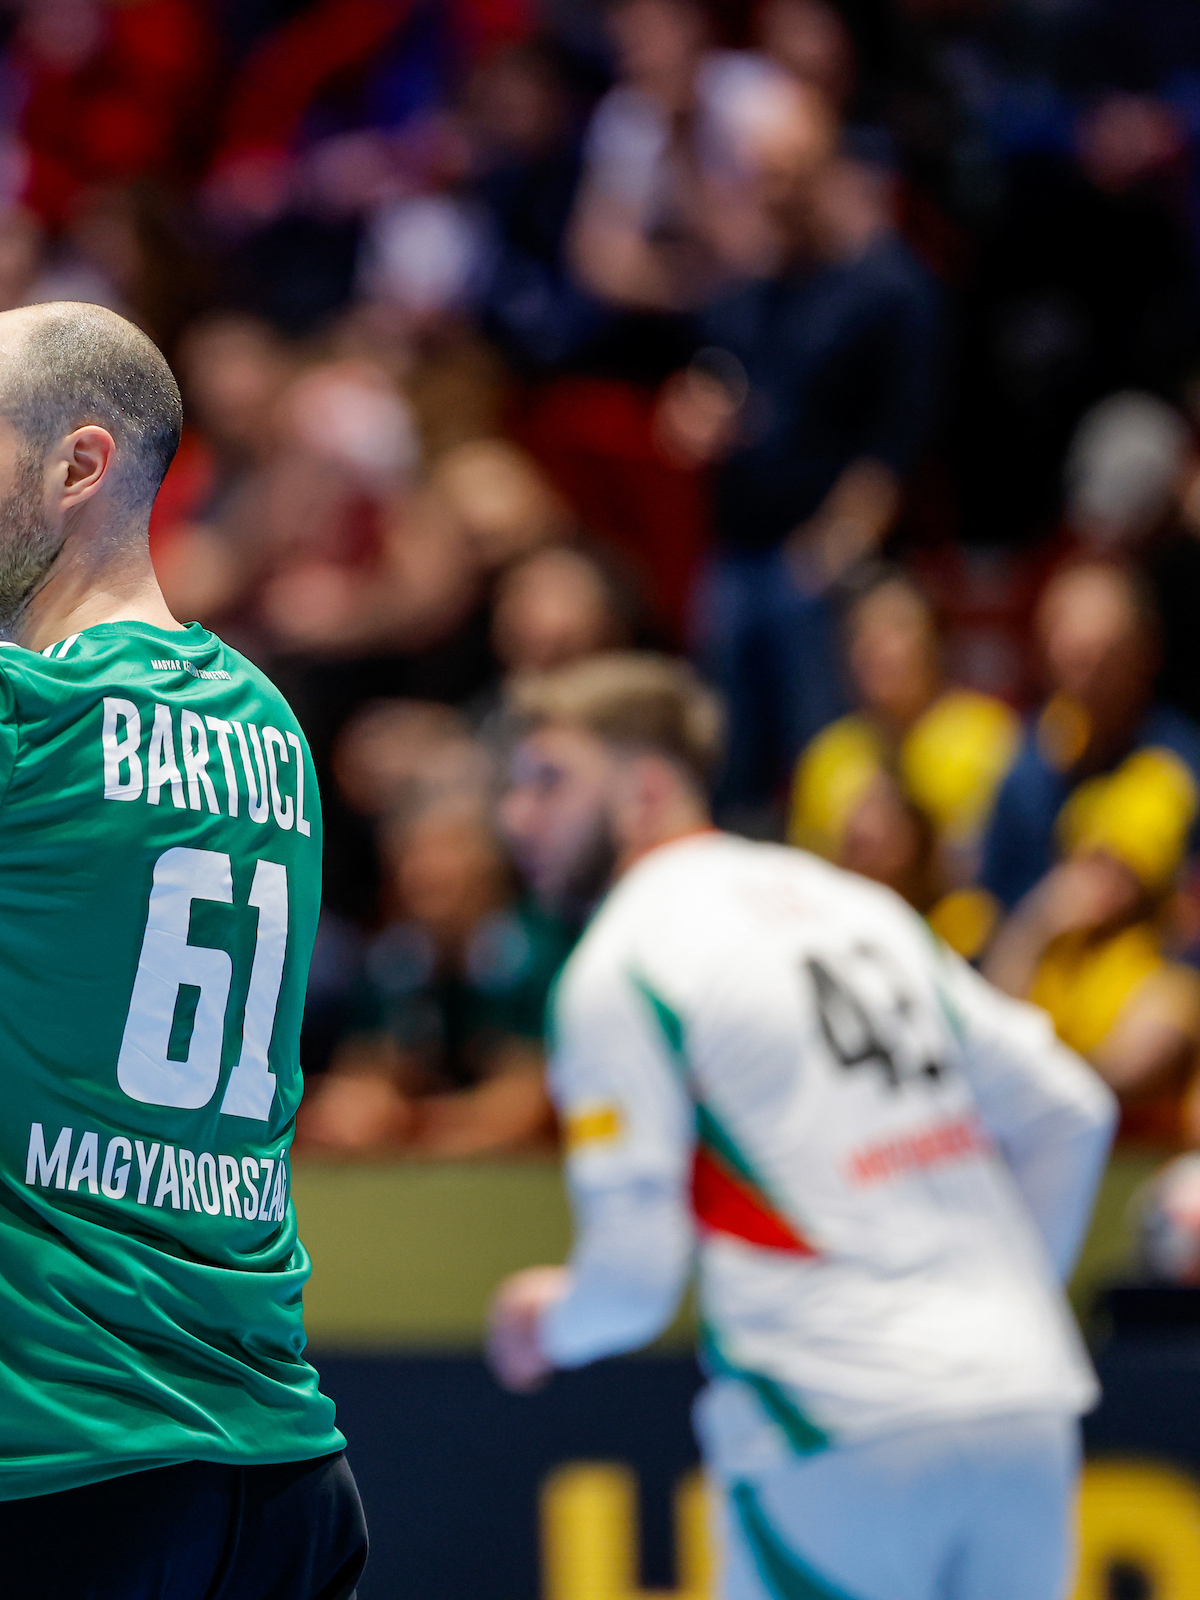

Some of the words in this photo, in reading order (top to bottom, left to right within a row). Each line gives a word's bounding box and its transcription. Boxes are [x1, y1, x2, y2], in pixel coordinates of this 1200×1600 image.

[150, 659, 181, 670] MAGYAR
[102, 696, 312, 838] BARTUCZ
[116, 846, 289, 1122] 61
